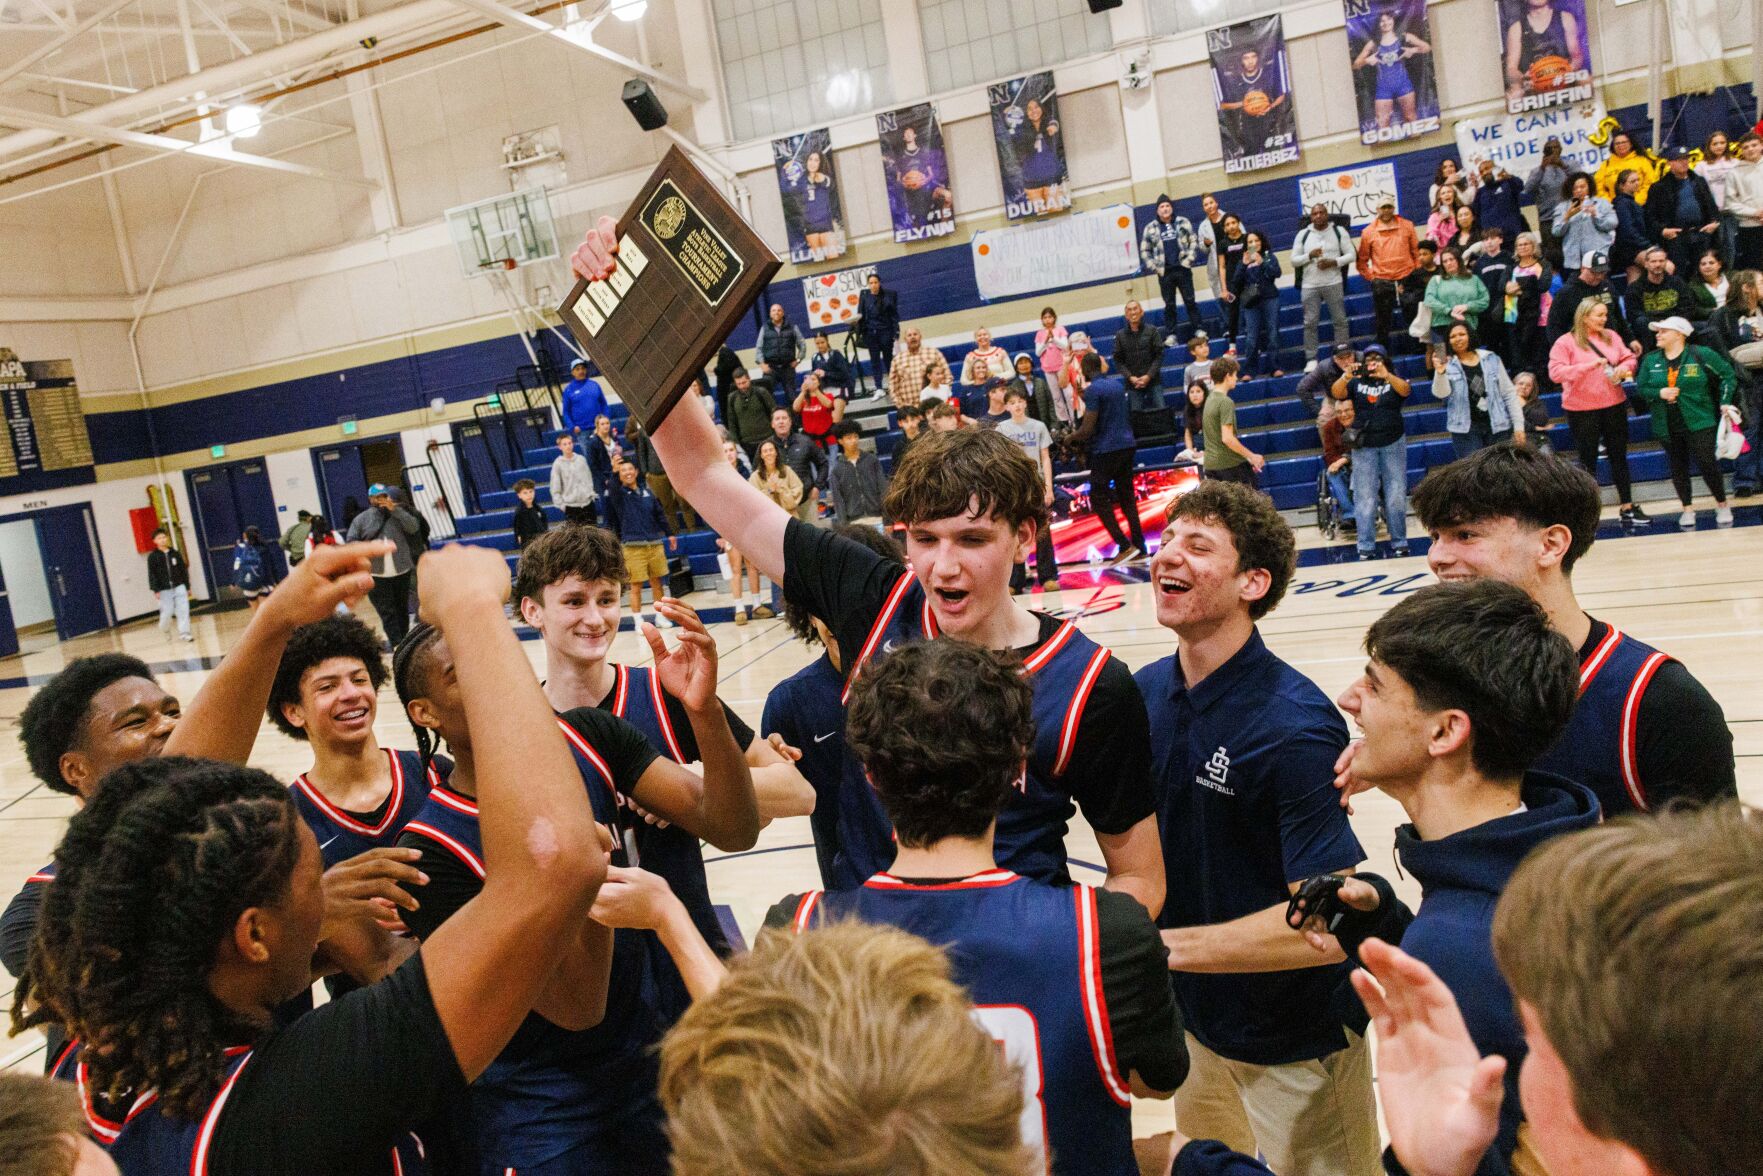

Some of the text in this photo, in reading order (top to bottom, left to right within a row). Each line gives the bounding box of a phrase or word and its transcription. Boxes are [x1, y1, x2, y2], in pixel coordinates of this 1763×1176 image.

[1508, 84, 1592, 114] GRIFFIN
[1264, 132, 1293, 148] #21
[1362, 116, 1440, 144] GOMEZ
[1471, 123, 1503, 142] WE
[1225, 146, 1299, 174] GUTIERREZ
[1489, 138, 1540, 164] HIDE
[926, 207, 952, 221] #15
[1008, 195, 1071, 218] DURAN
[895, 220, 955, 243] FLYNN
[679, 251, 711, 290] CHAMPIONS
[681, 240, 719, 286] TOURNAMENT
[1195, 775, 1235, 796] BASKETBALL
